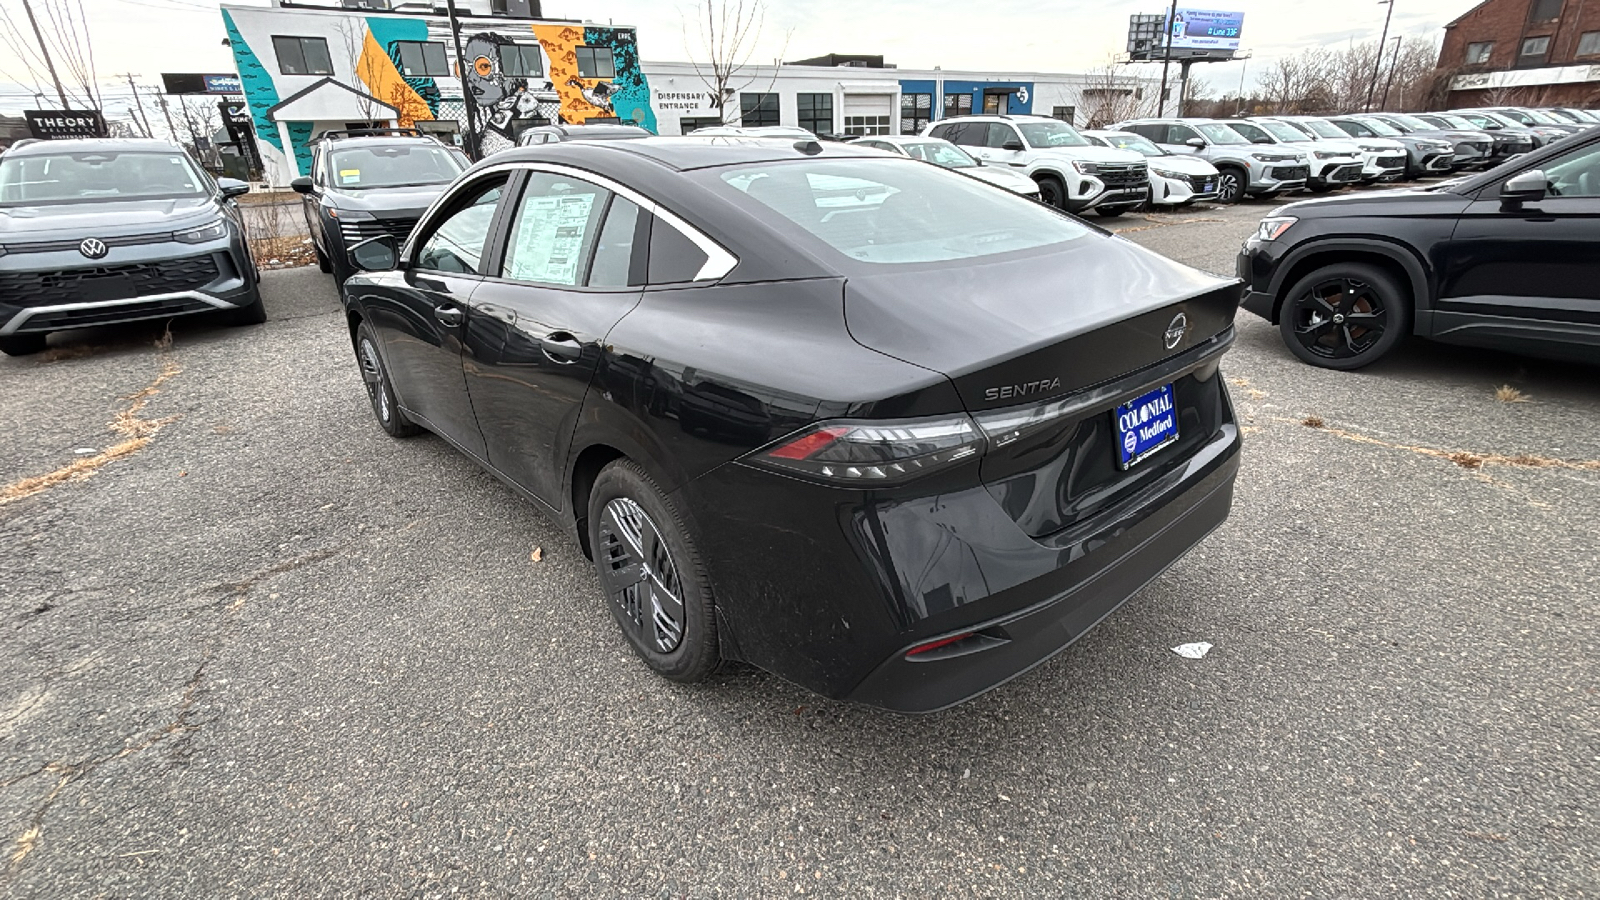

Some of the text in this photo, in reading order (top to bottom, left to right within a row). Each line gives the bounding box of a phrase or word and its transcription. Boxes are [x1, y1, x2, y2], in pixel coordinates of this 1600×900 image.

[33, 117, 95, 127] THEORY
[985, 378, 1061, 401] SENTRA
[1119, 394, 1172, 432] COLONIAL
[1139, 414, 1172, 443] Medford
